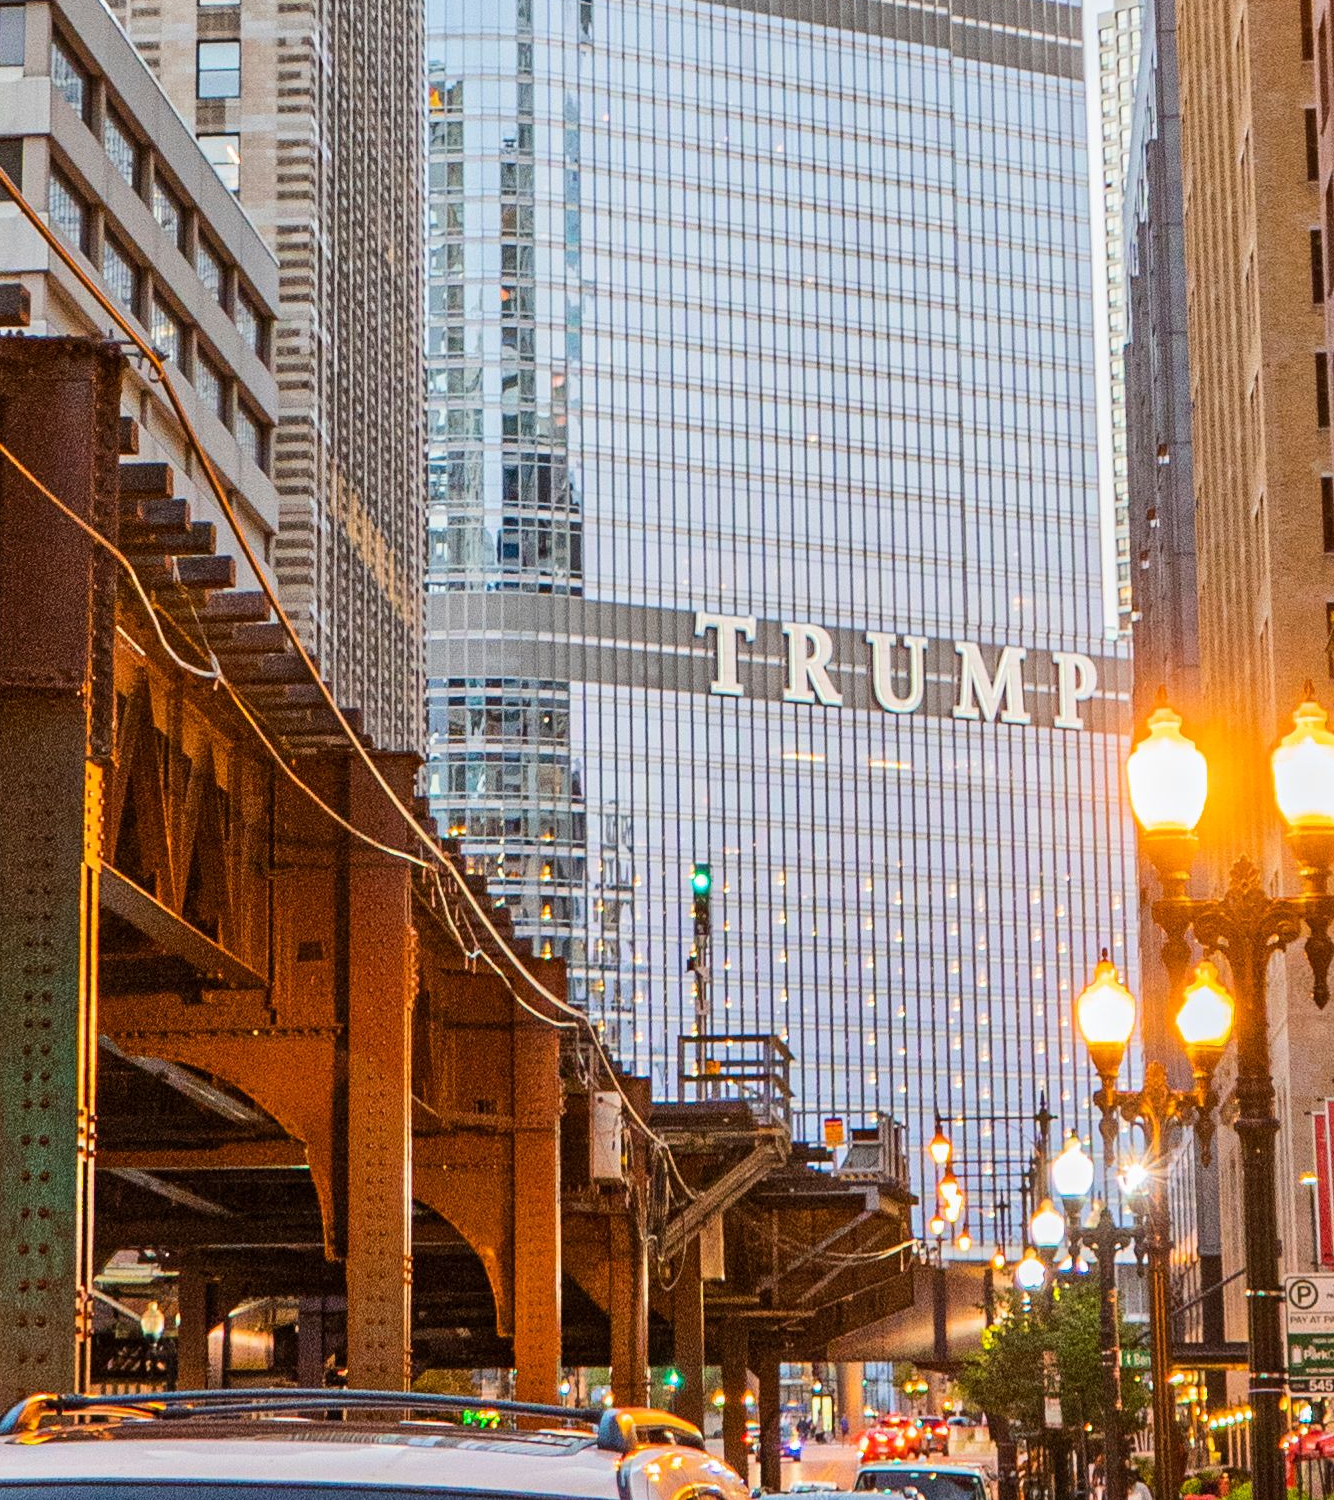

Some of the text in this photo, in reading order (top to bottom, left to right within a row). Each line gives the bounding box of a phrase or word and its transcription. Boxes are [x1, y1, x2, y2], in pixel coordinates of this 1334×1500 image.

[695, 611, 1098, 730] TRUMP
[1290, 1315, 1308, 1324] PAY
[1309, 1315, 1321, 1324] AT
[1309, 1379, 1334, 1392] 545
